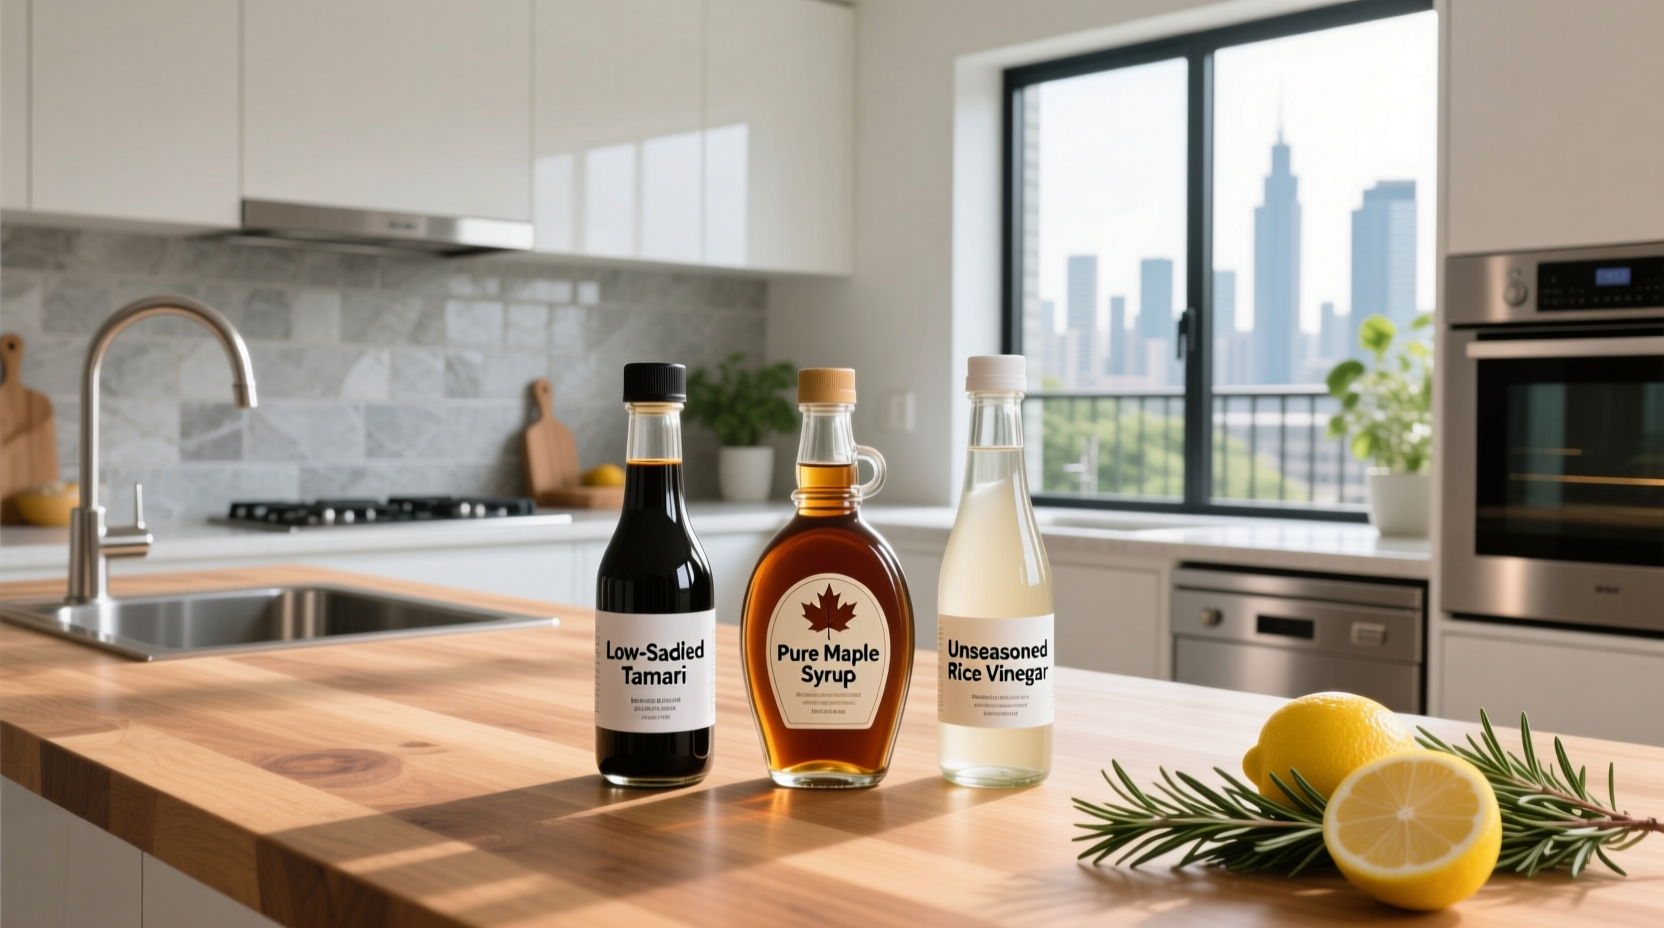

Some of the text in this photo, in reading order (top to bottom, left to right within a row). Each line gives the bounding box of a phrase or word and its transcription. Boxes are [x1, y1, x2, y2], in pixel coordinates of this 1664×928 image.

[777, 643, 880, 667] Pure Maple
[948, 638, 1048, 660] Unseasoned
[621, 665, 687, 685] Tamari
[801, 664, 857, 689] Syrup
[948, 661, 1049, 686] Rice Vinegar
